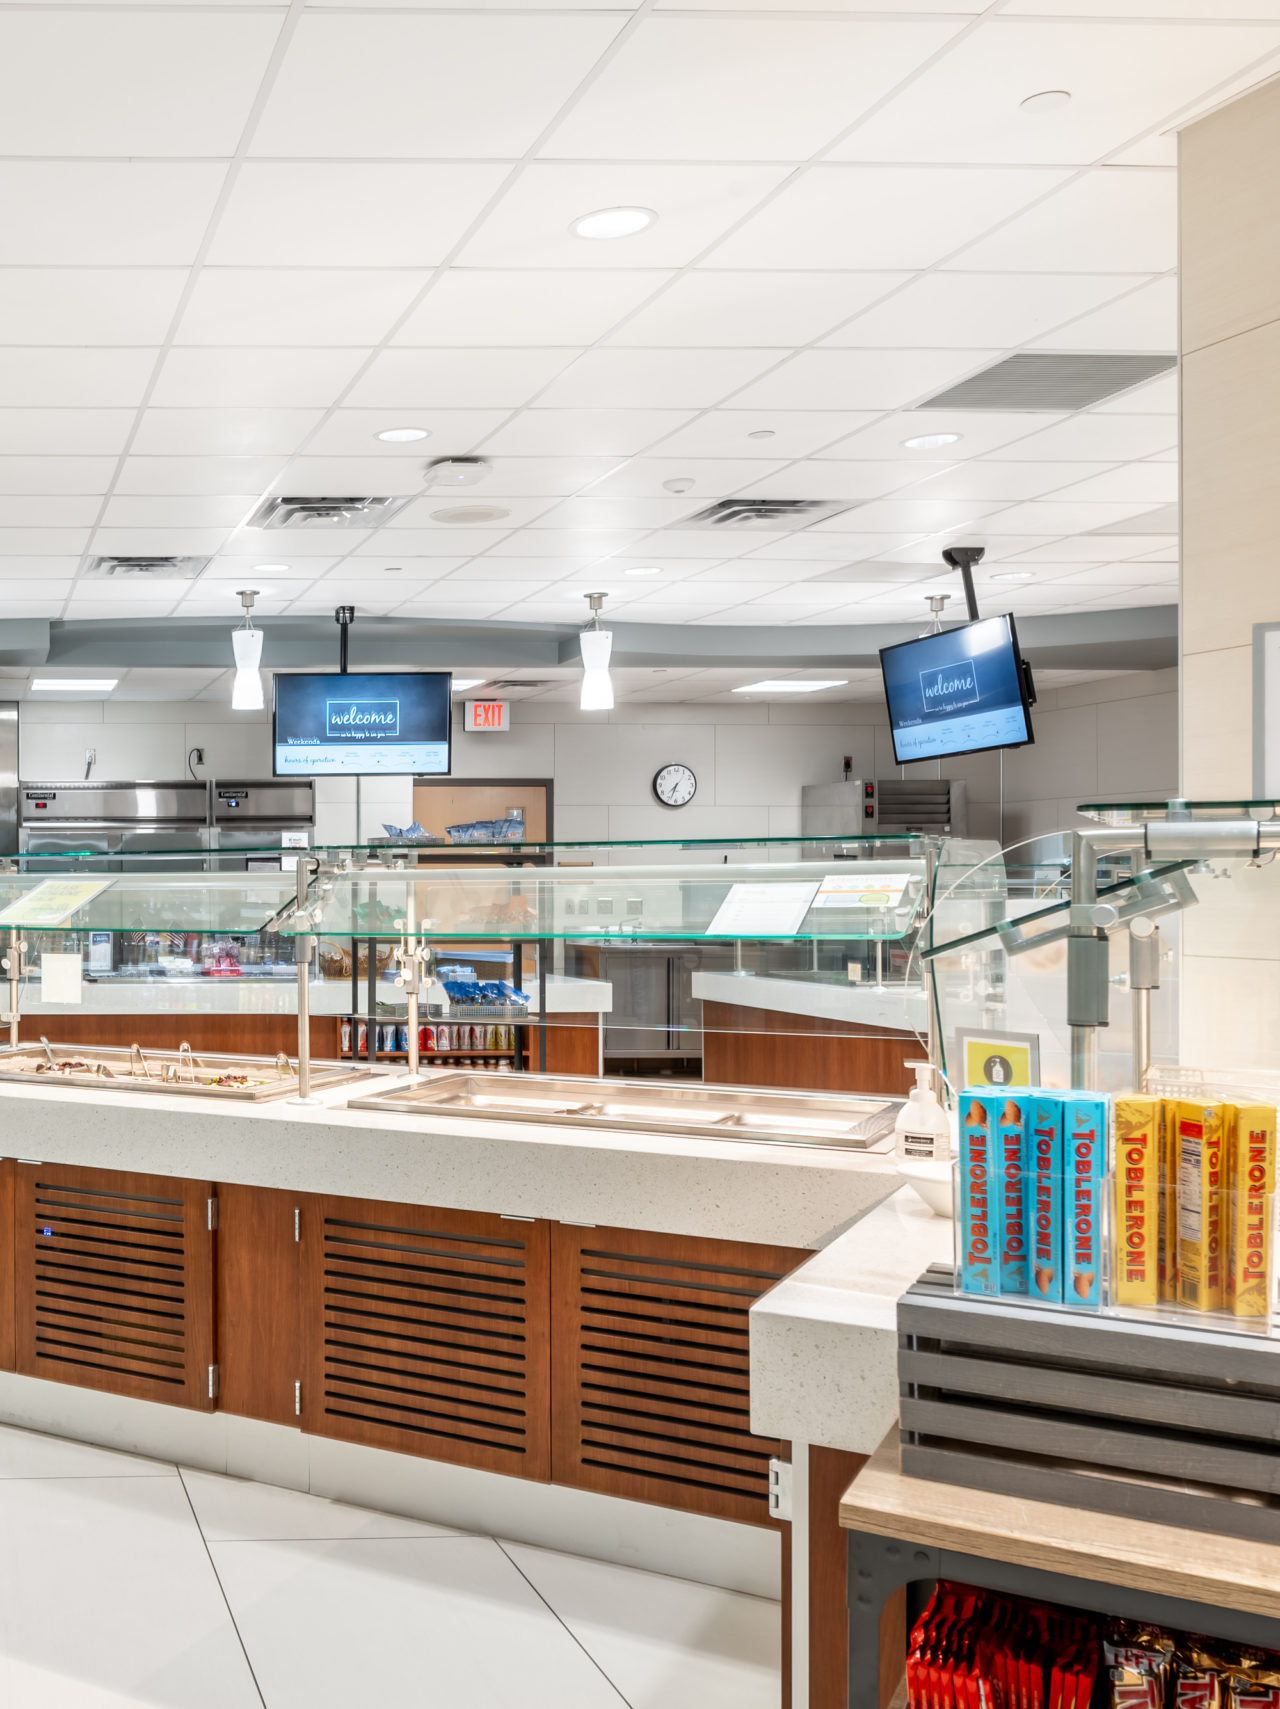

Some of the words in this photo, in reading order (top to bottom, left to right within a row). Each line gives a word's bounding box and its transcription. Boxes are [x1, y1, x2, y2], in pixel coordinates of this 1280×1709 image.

[331, 706, 396, 724] welcome
[474, 704, 504, 726] EXIT
[926, 674, 974, 697] welcome
[968, 1135, 992, 1266] TOBLERONE
[1004, 1134, 1026, 1264] TOBLERONE
[1034, 1127, 1054, 1261] TOBLERONE
[1072, 1129, 1095, 1264] TOBLERONE
[1122, 1133, 1148, 1283] TOBLERONE
[1206, 1136, 1220, 1288] TOBLERONE
[1243, 1130, 1267, 1283] TOBLERONE
